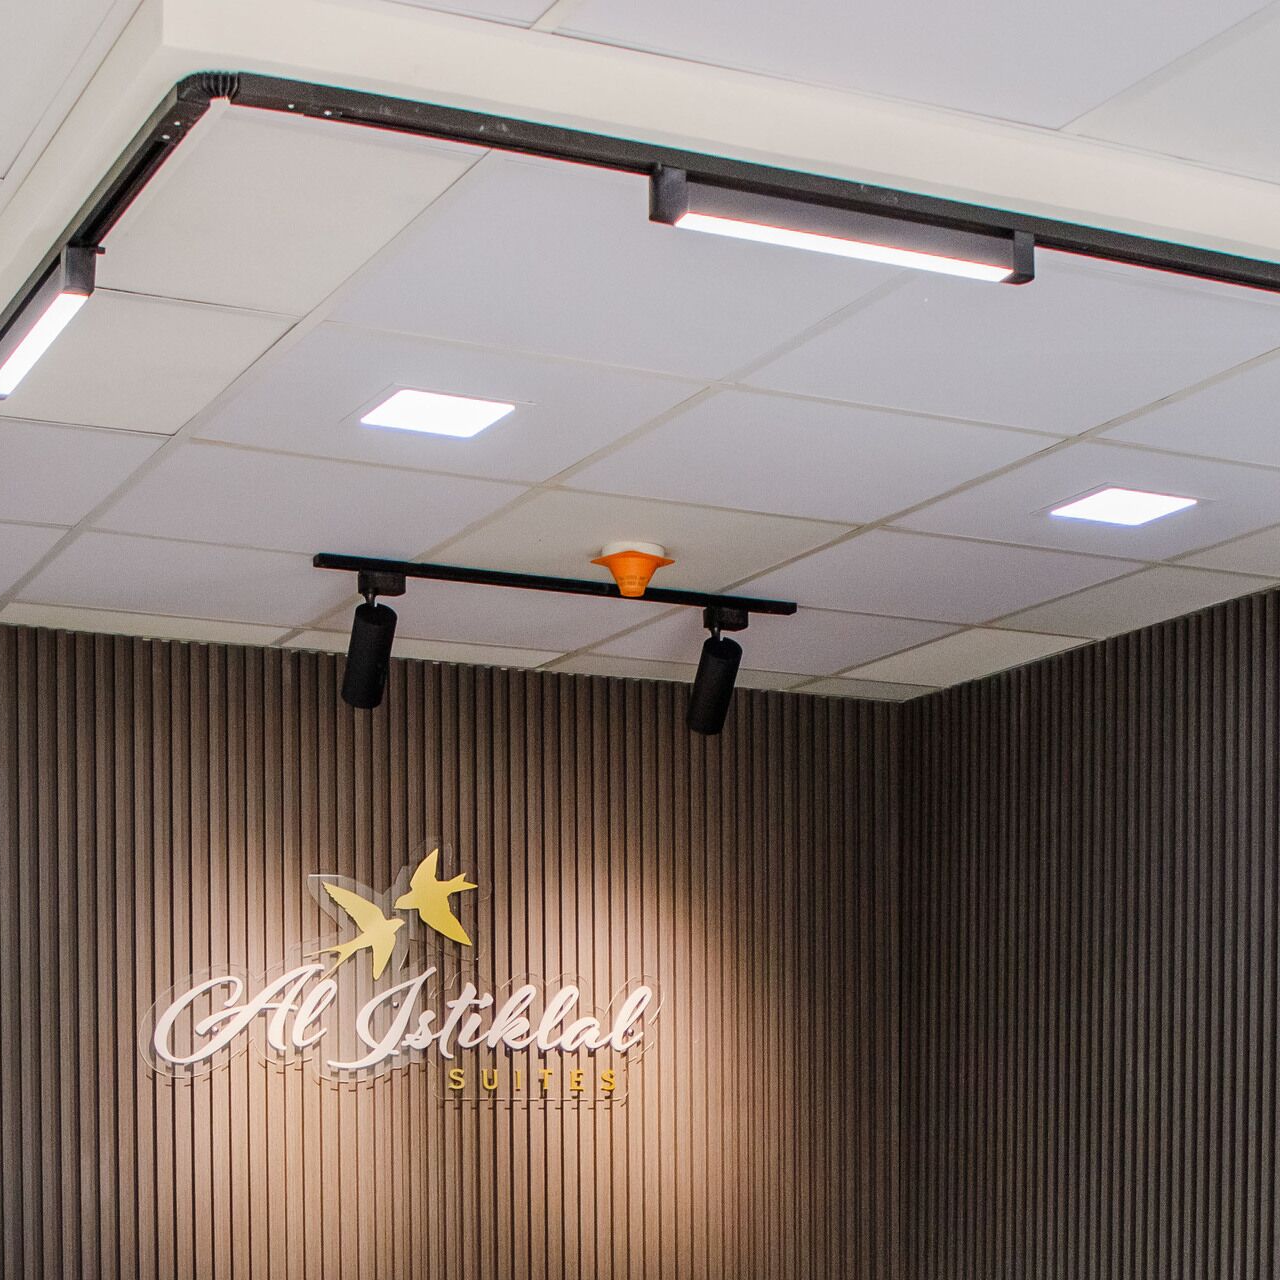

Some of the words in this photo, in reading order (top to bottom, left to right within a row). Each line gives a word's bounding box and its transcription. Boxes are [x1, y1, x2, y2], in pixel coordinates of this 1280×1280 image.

[154, 964, 337, 1065] Al
[328, 967, 652, 1070] Istiklal
[448, 1068, 617, 1092] SUITES
